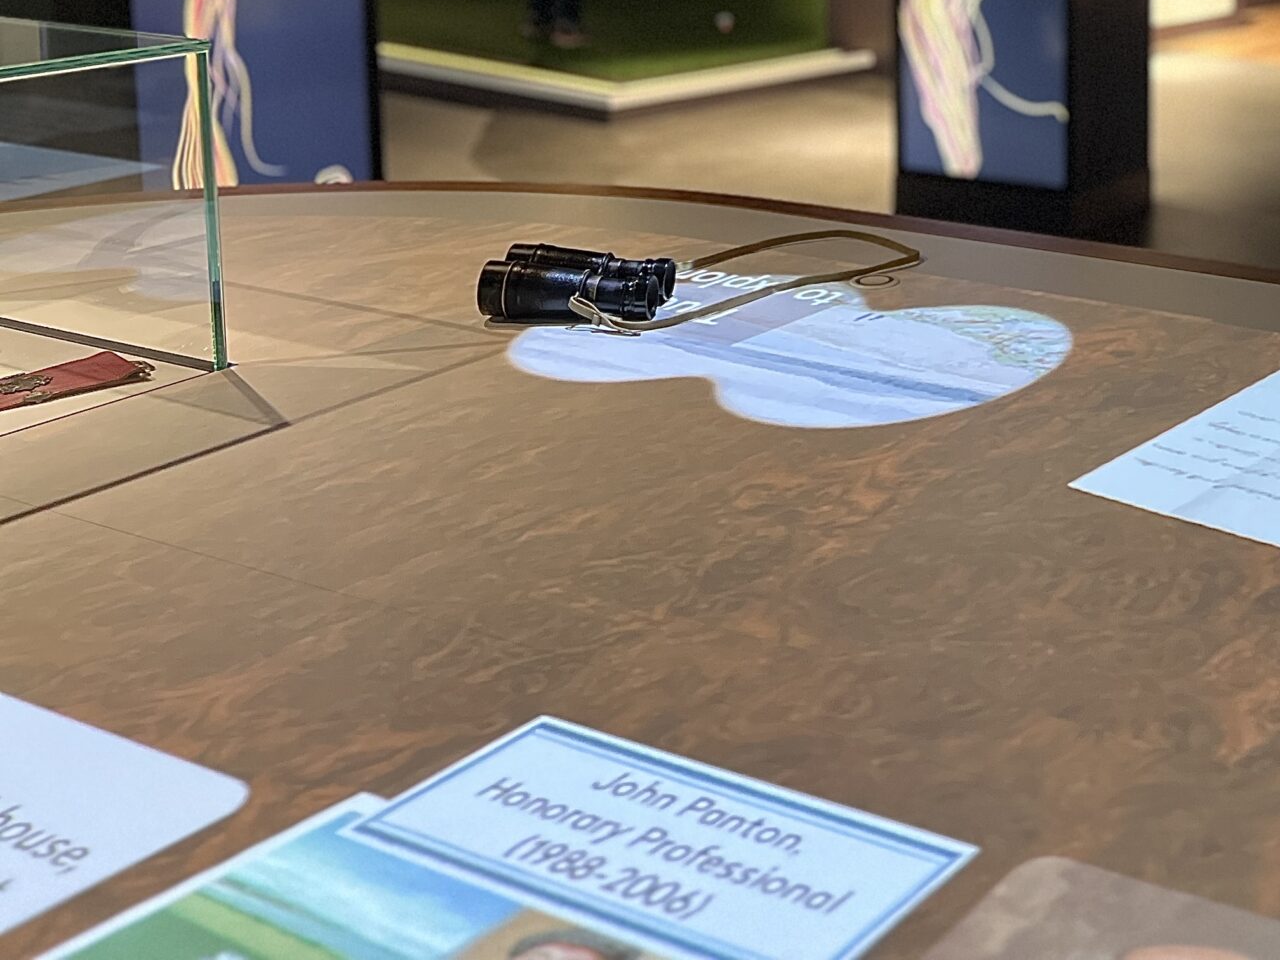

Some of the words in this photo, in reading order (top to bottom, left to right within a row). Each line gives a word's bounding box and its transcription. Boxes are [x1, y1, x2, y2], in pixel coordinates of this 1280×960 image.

[793, 288, 845, 306] to
[476, 776, 636, 845] Honorary
[627, 826, 857, 915] Professional
[590, 771, 675, 811] John
[675, 796, 804, 856] Panton,
[502, 833, 716, 921] (1988-2006)
